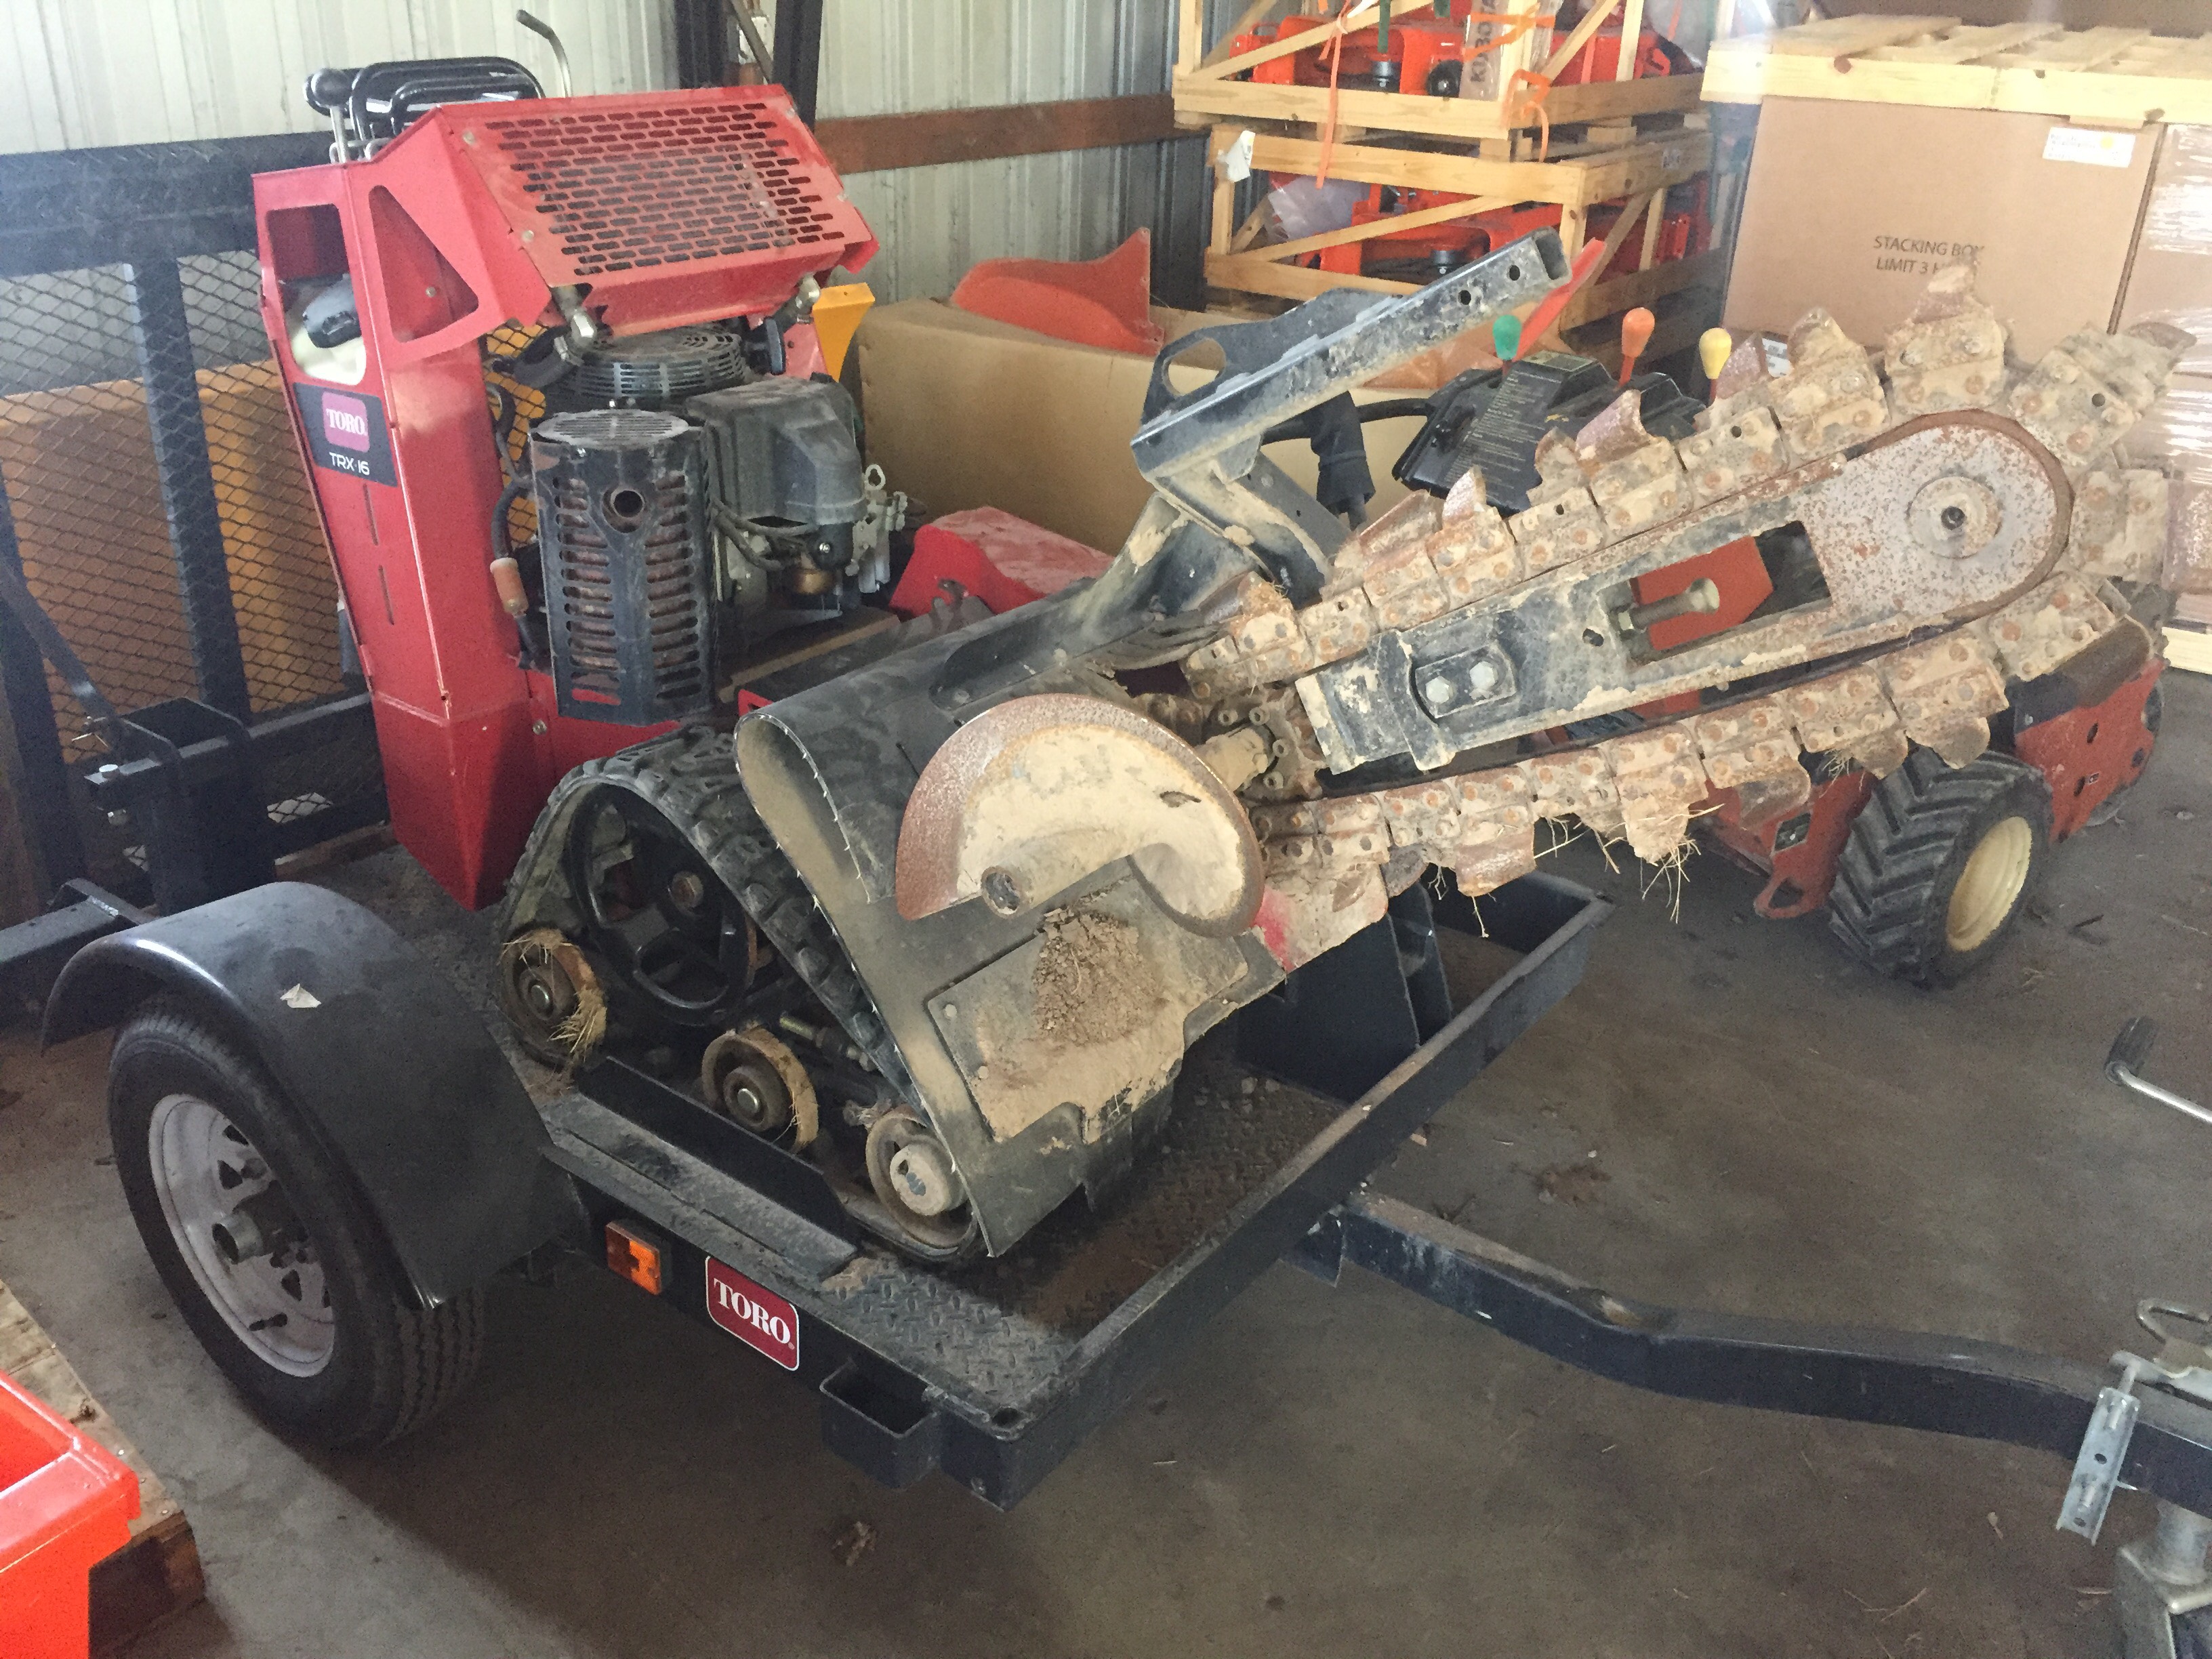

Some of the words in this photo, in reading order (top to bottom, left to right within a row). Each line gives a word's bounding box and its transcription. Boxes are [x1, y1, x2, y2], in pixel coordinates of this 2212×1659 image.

[1469, 0, 1496, 82] KUBOA
[1873, 235, 1948, 255] STACKING
[1876, 257, 1917, 274] LIMIT
[1919, 262, 1929, 274] 3
[326, 408, 367, 435] TORO
[714, 1278, 791, 1344] TORO
